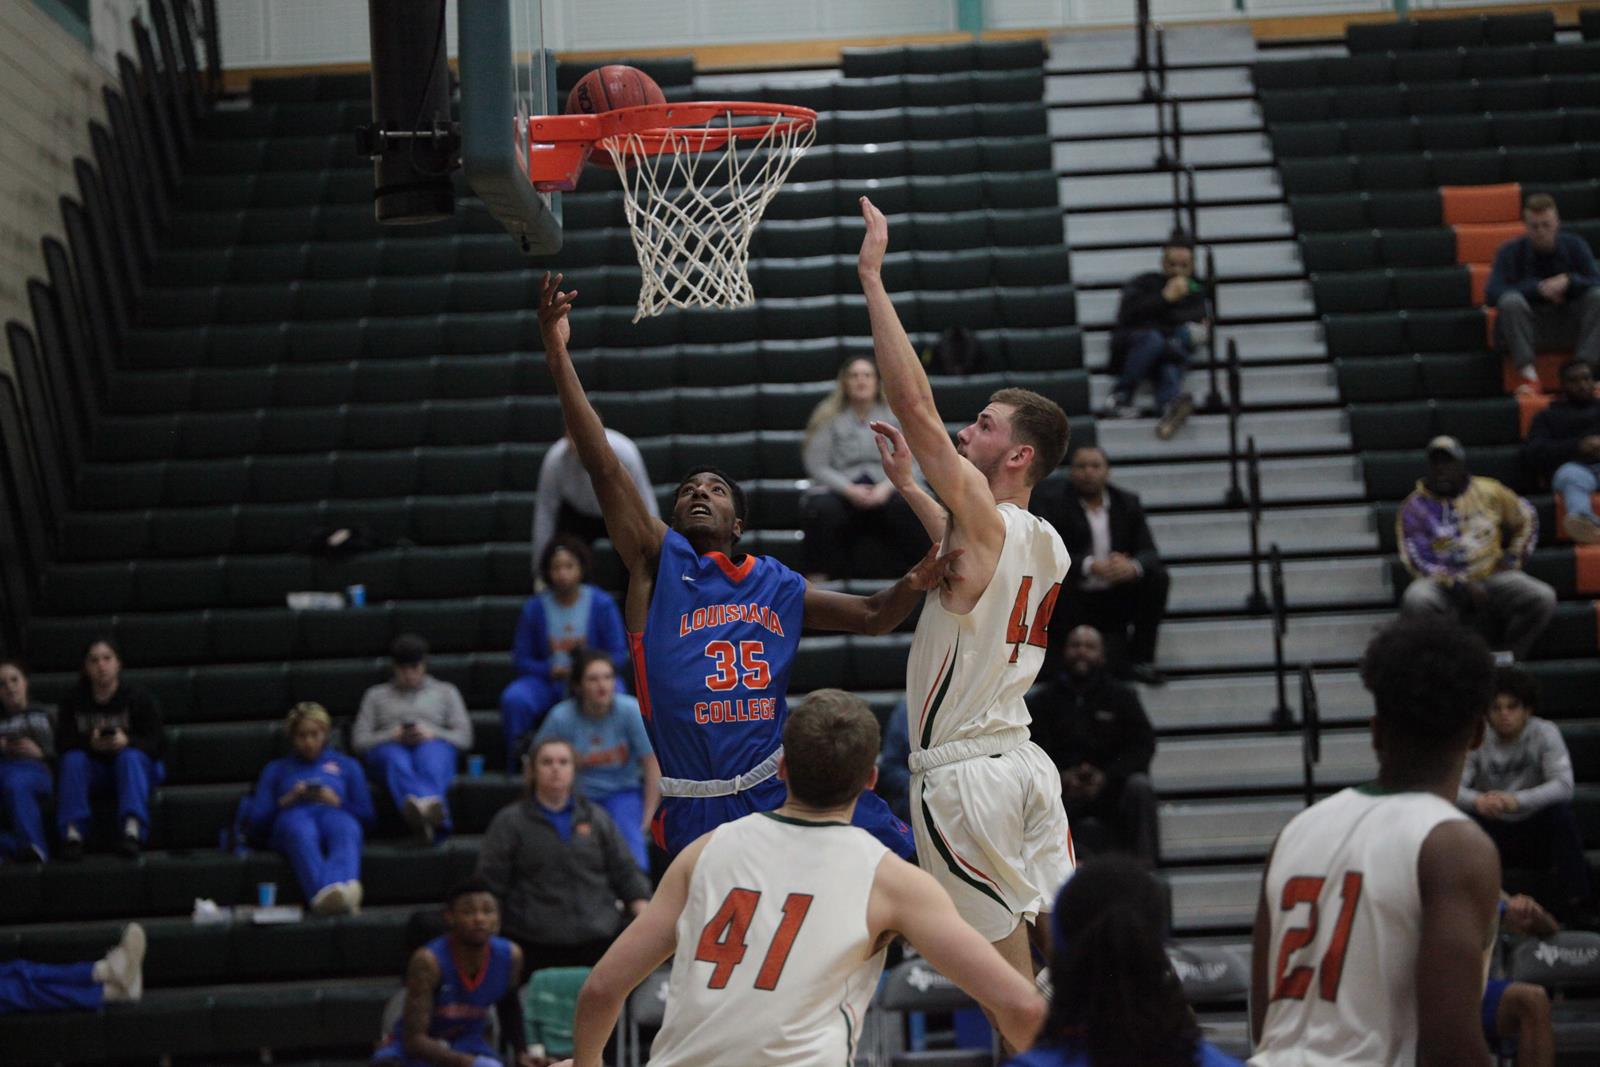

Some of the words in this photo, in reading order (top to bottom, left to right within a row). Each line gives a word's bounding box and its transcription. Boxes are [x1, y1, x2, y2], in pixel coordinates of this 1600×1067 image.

[704, 639, 772, 692] 35
[695, 887, 814, 991] 41
[1272, 870, 1364, 1003] 21
